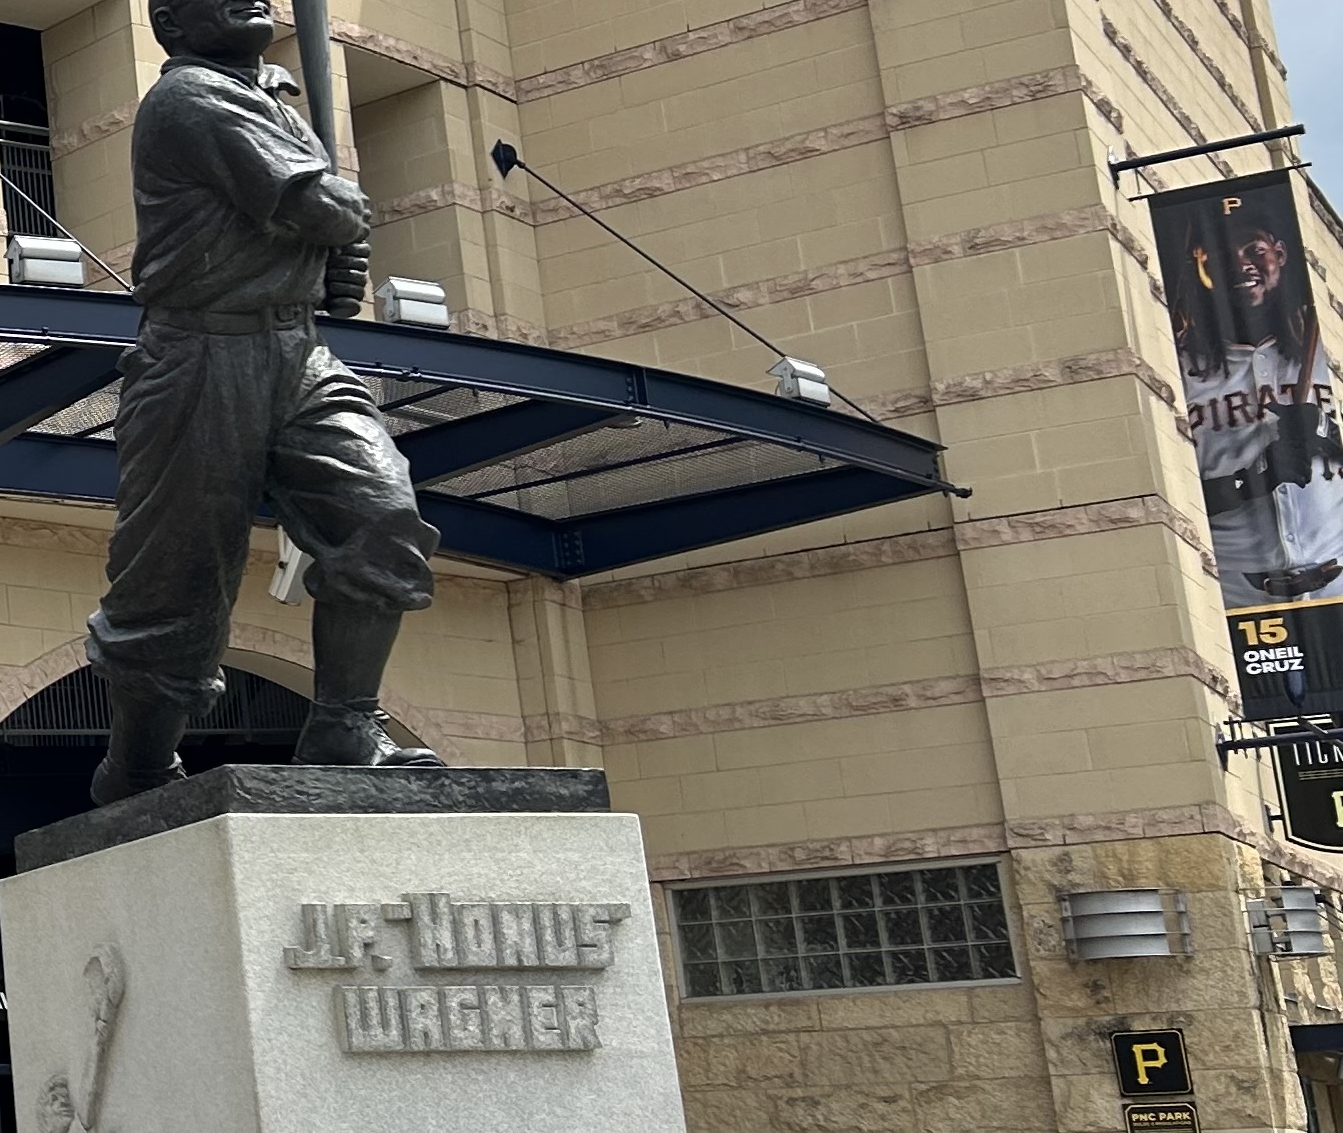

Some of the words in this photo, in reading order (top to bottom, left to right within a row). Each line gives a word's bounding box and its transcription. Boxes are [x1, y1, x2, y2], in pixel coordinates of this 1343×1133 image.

[1221, 197, 1242, 215] P
[1238, 617, 1288, 645] 15
[1243, 646, 1304, 663] ONEIL
[1245, 658, 1305, 675] CRUZ
[332, 984, 604, 1053] WAGNER
[1131, 1042, 1168, 1085] P
[1131, 1112, 1157, 1122] PNC
[1158, 1111, 1192, 1121] PARK
